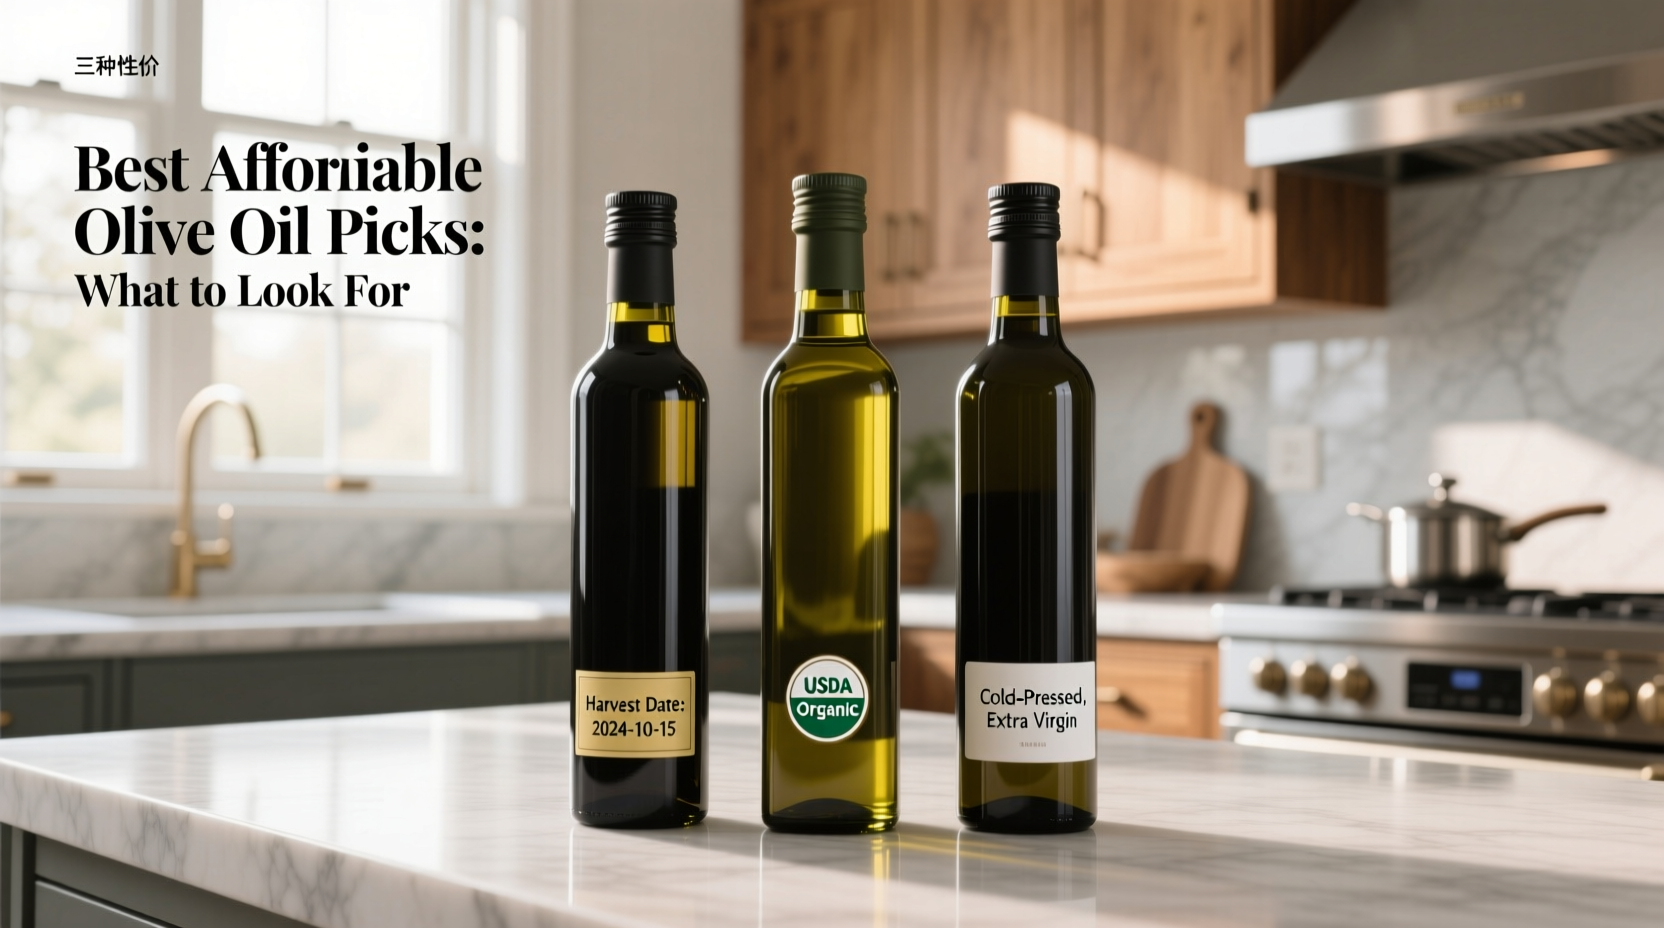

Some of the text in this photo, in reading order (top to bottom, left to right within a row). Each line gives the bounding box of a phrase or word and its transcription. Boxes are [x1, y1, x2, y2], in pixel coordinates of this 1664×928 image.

[803, 676, 853, 694] USDA
[585, 695, 685, 713] Harvest Date:
[980, 686, 1087, 706] Cold-Pressed,
[592, 720, 677, 737] 2024-10-15
[987, 711, 1077, 733] Extra Virgin
